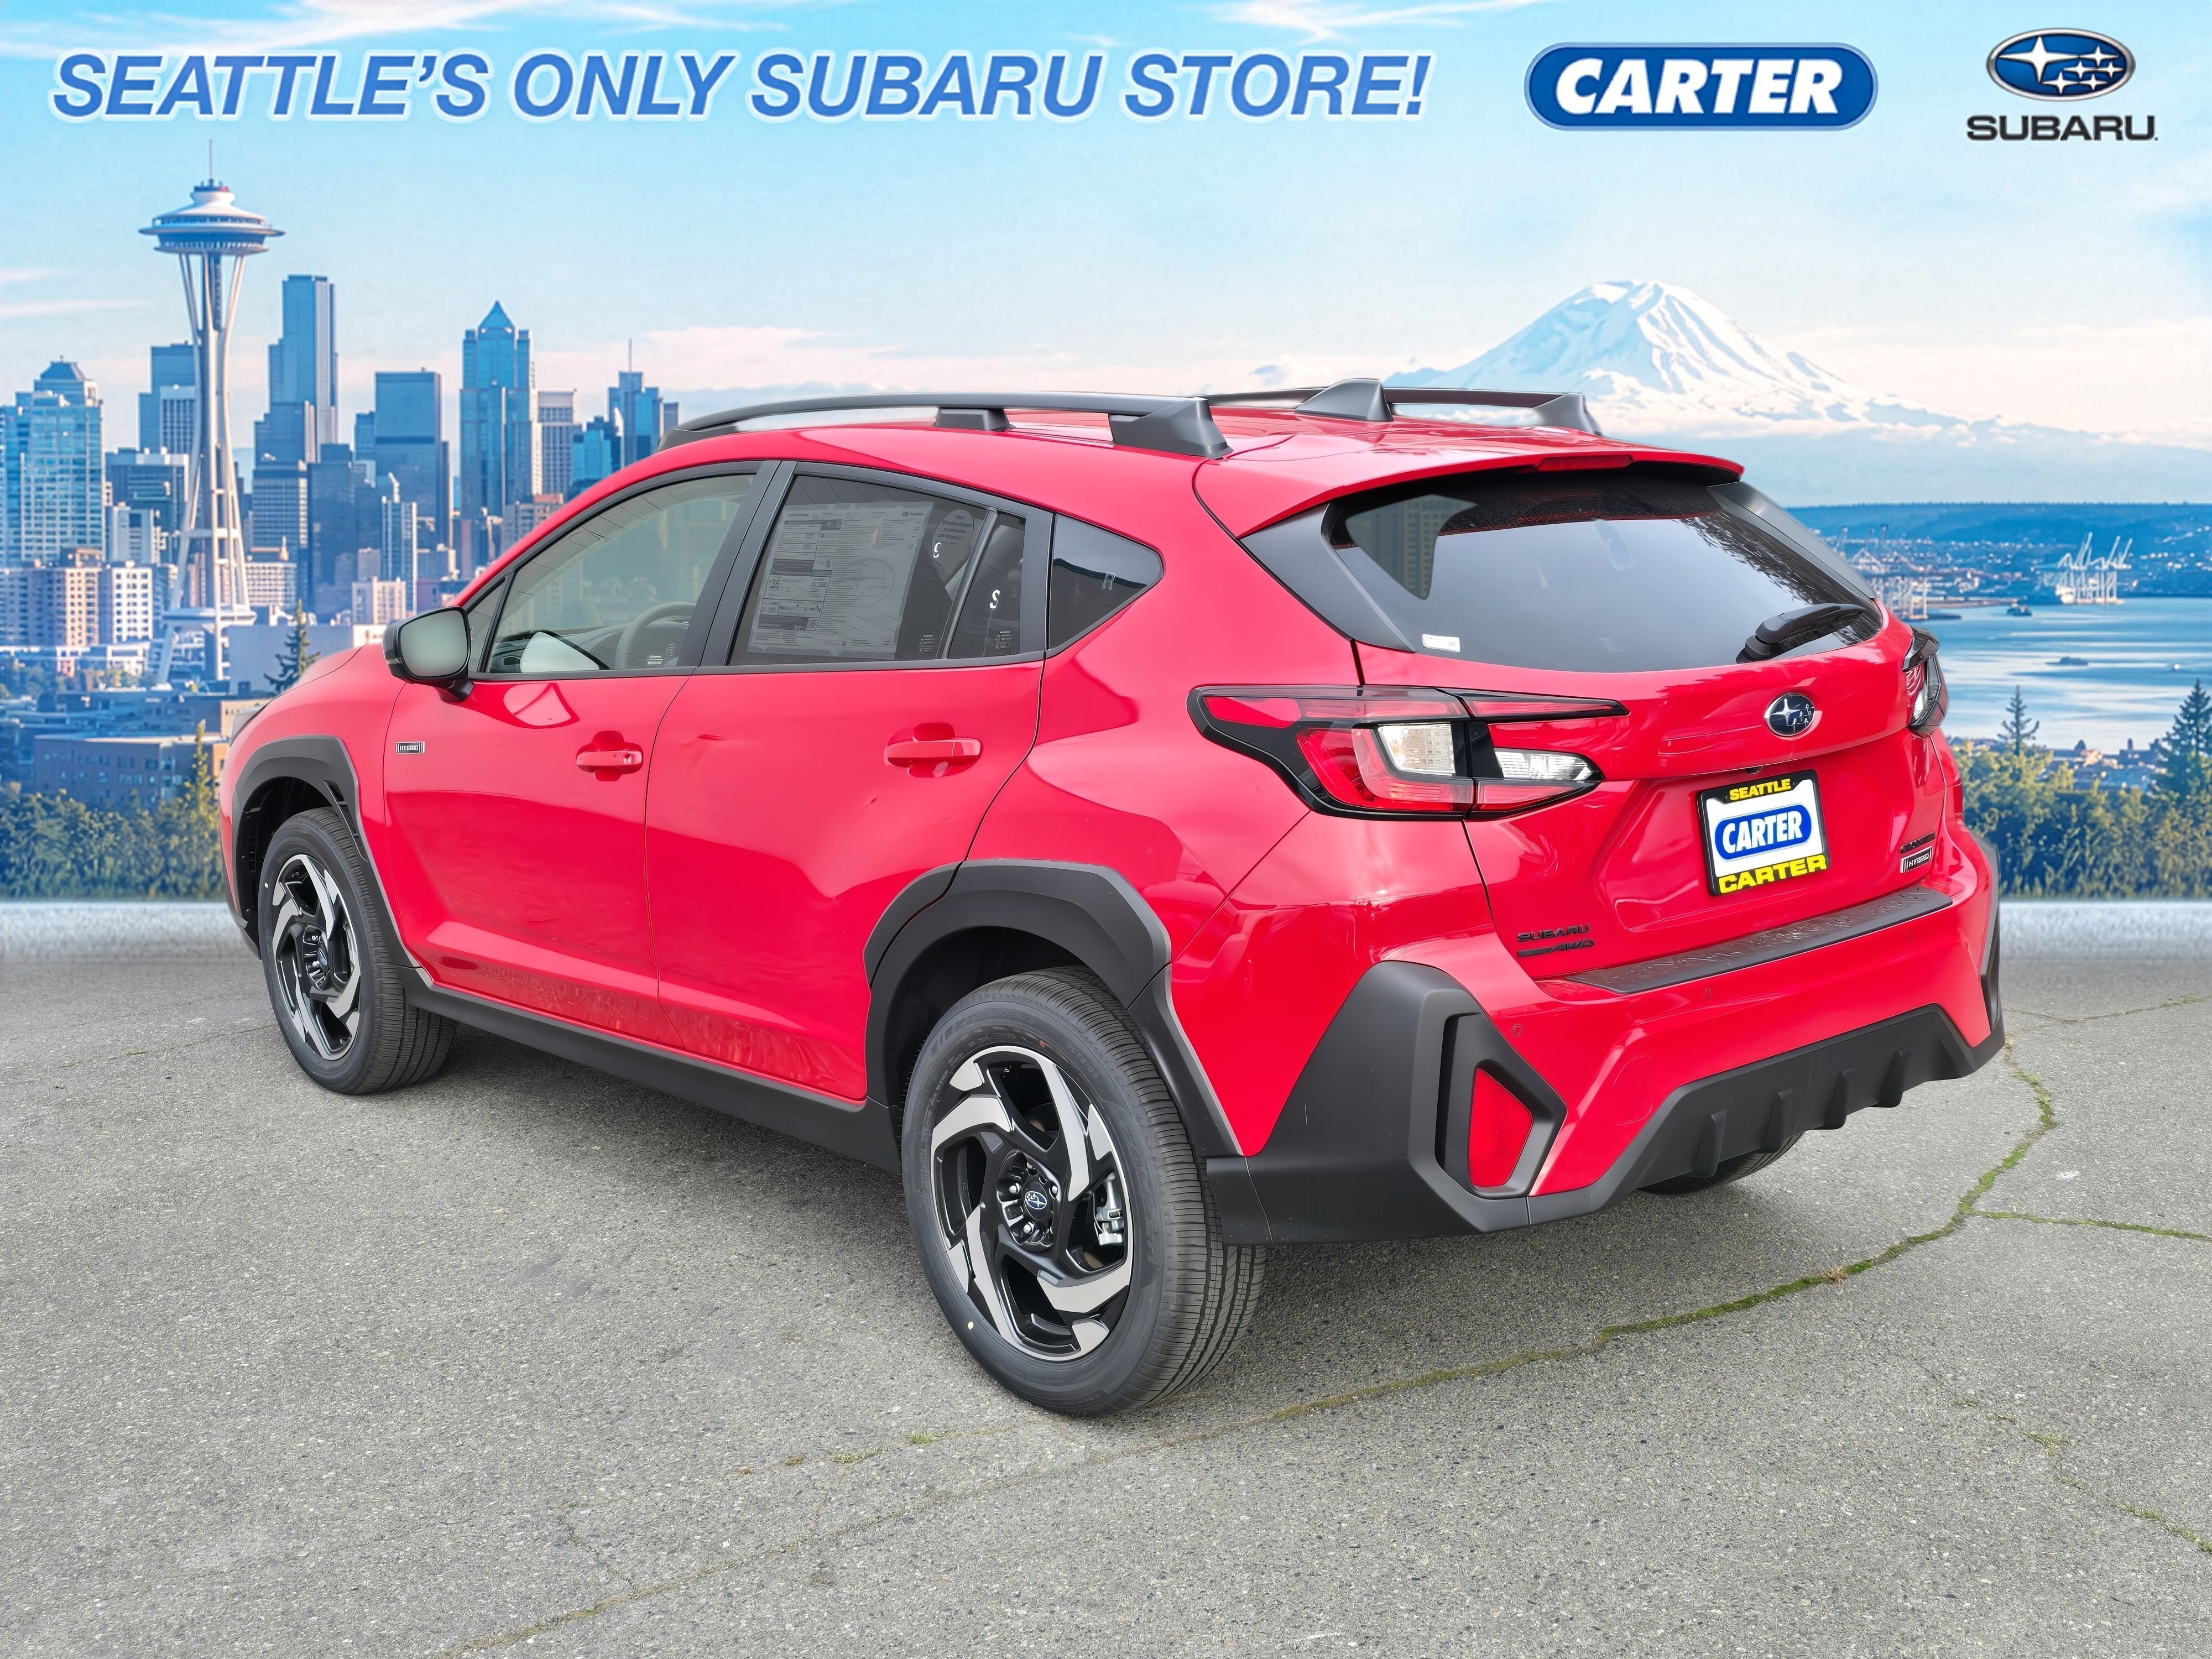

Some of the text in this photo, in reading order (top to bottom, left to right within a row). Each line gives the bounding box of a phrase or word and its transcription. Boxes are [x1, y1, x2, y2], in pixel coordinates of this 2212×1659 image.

[1729, 778, 1792, 801] SEATTLE
[1721, 810, 1803, 854] CARTER
[1718, 854, 1827, 894] CARTER
[1517, 923, 1590, 942] SUBARU
